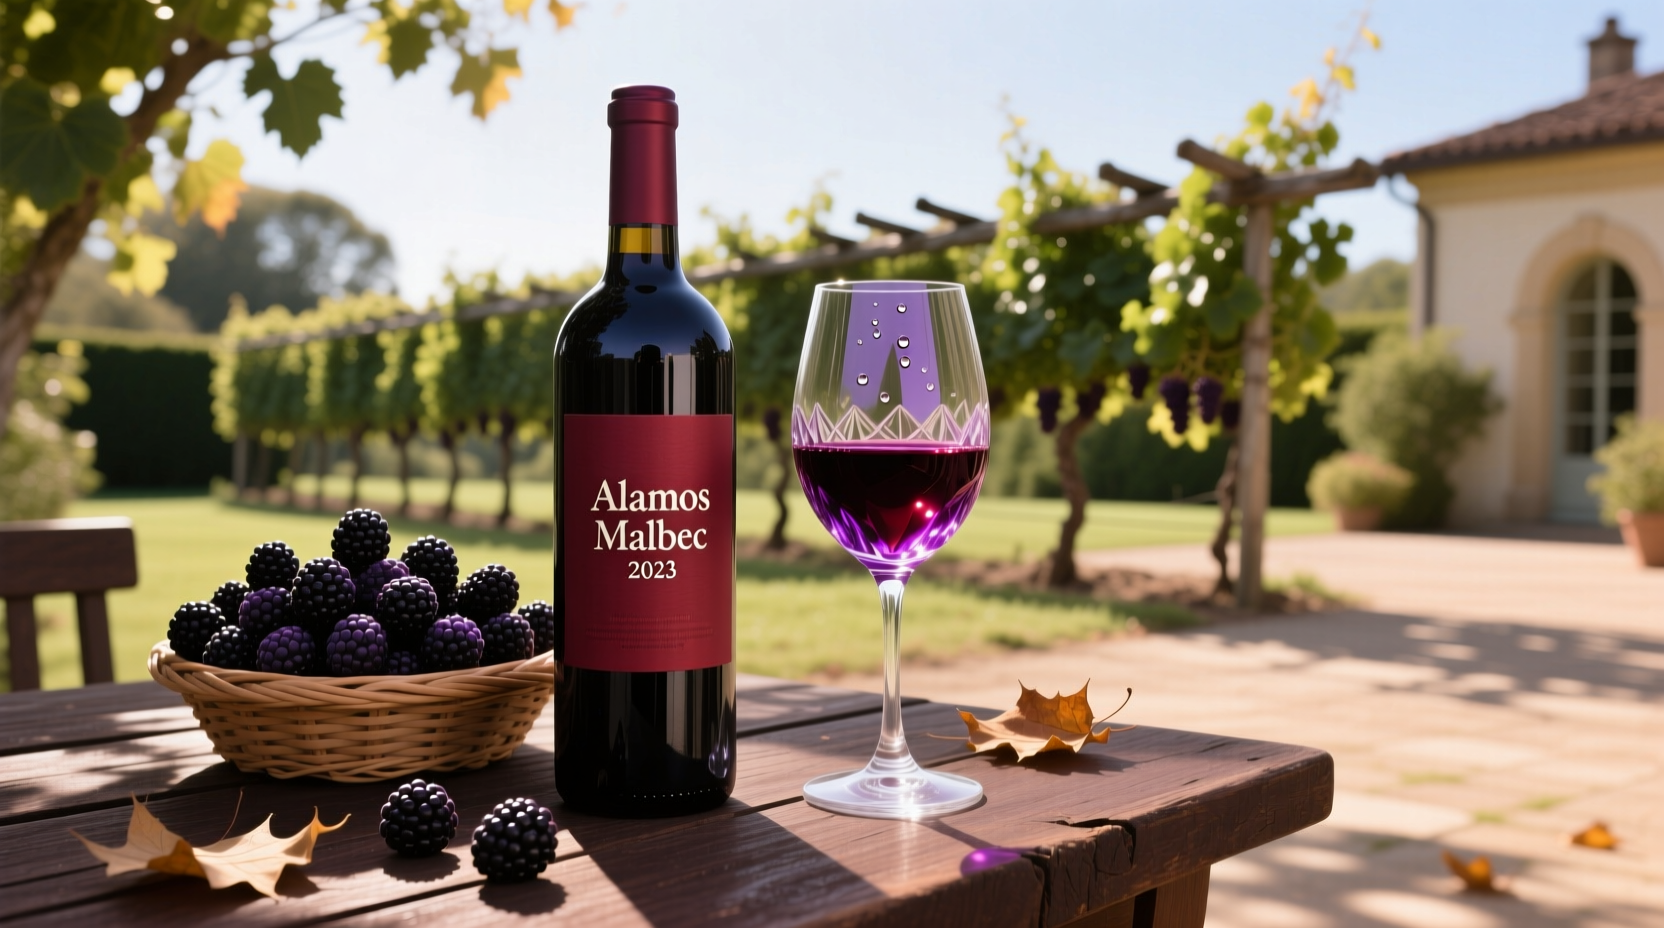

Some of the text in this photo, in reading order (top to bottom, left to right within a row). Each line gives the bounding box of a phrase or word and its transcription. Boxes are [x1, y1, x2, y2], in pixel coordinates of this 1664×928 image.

[590, 478, 711, 512] Alamos
[593, 518, 708, 551] Malbec
[627, 559, 678, 580] 2023
